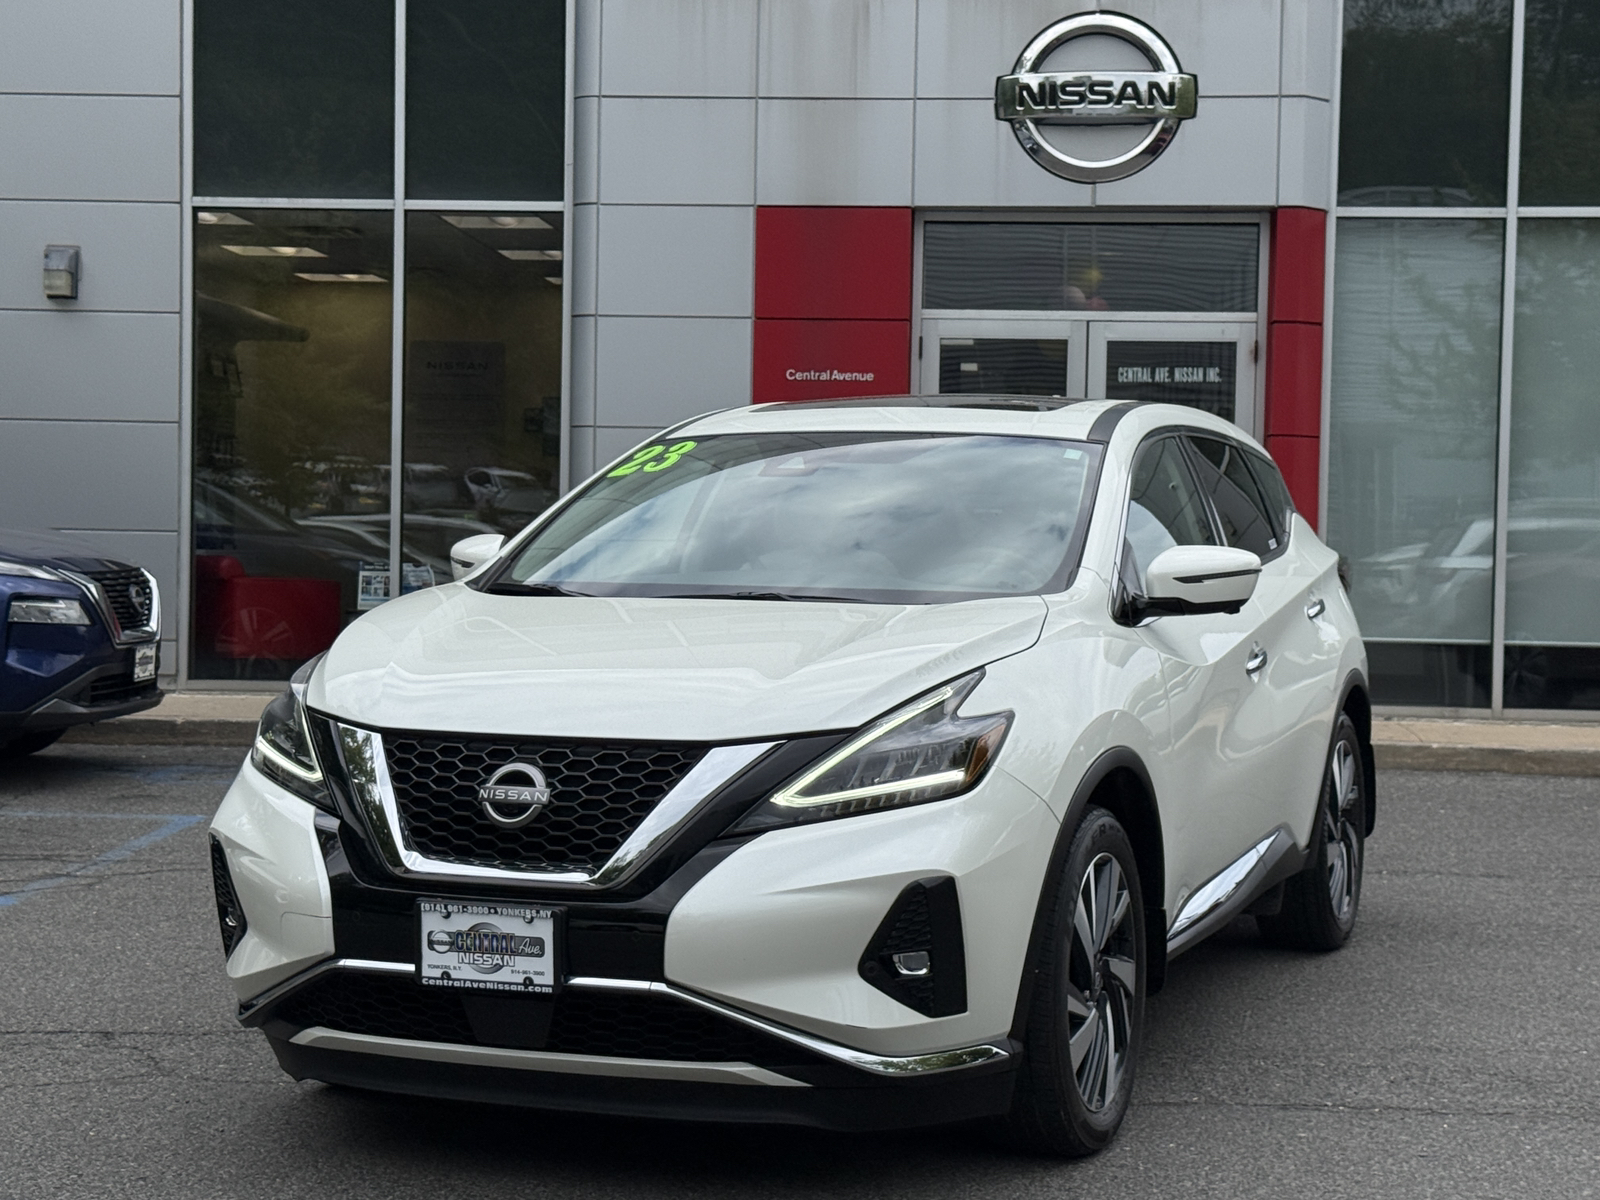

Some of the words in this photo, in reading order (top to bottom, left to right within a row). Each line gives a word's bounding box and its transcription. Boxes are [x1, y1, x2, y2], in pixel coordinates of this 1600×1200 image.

[1015, 80, 1177, 110] NISSAN
[427, 361, 489, 371] NISSAN
[1117, 366, 1152, 383] CENTRAL
[1154, 366, 1172, 383] AVE.
[1173, 366, 1204, 383] NISSAN
[1206, 366, 1222, 383] INC.
[785, 369, 830, 381] Central
[831, 370, 875, 382] Avenue
[606, 441, 698, 478] 23
[479, 788, 548, 802] NISSAN
[455, 930, 517, 955] CENTRAL
[518, 937, 543, 956] Ave.
[457, 952, 516, 968] NISSAN
[421, 977, 553, 994] CentralAveNissan.com
